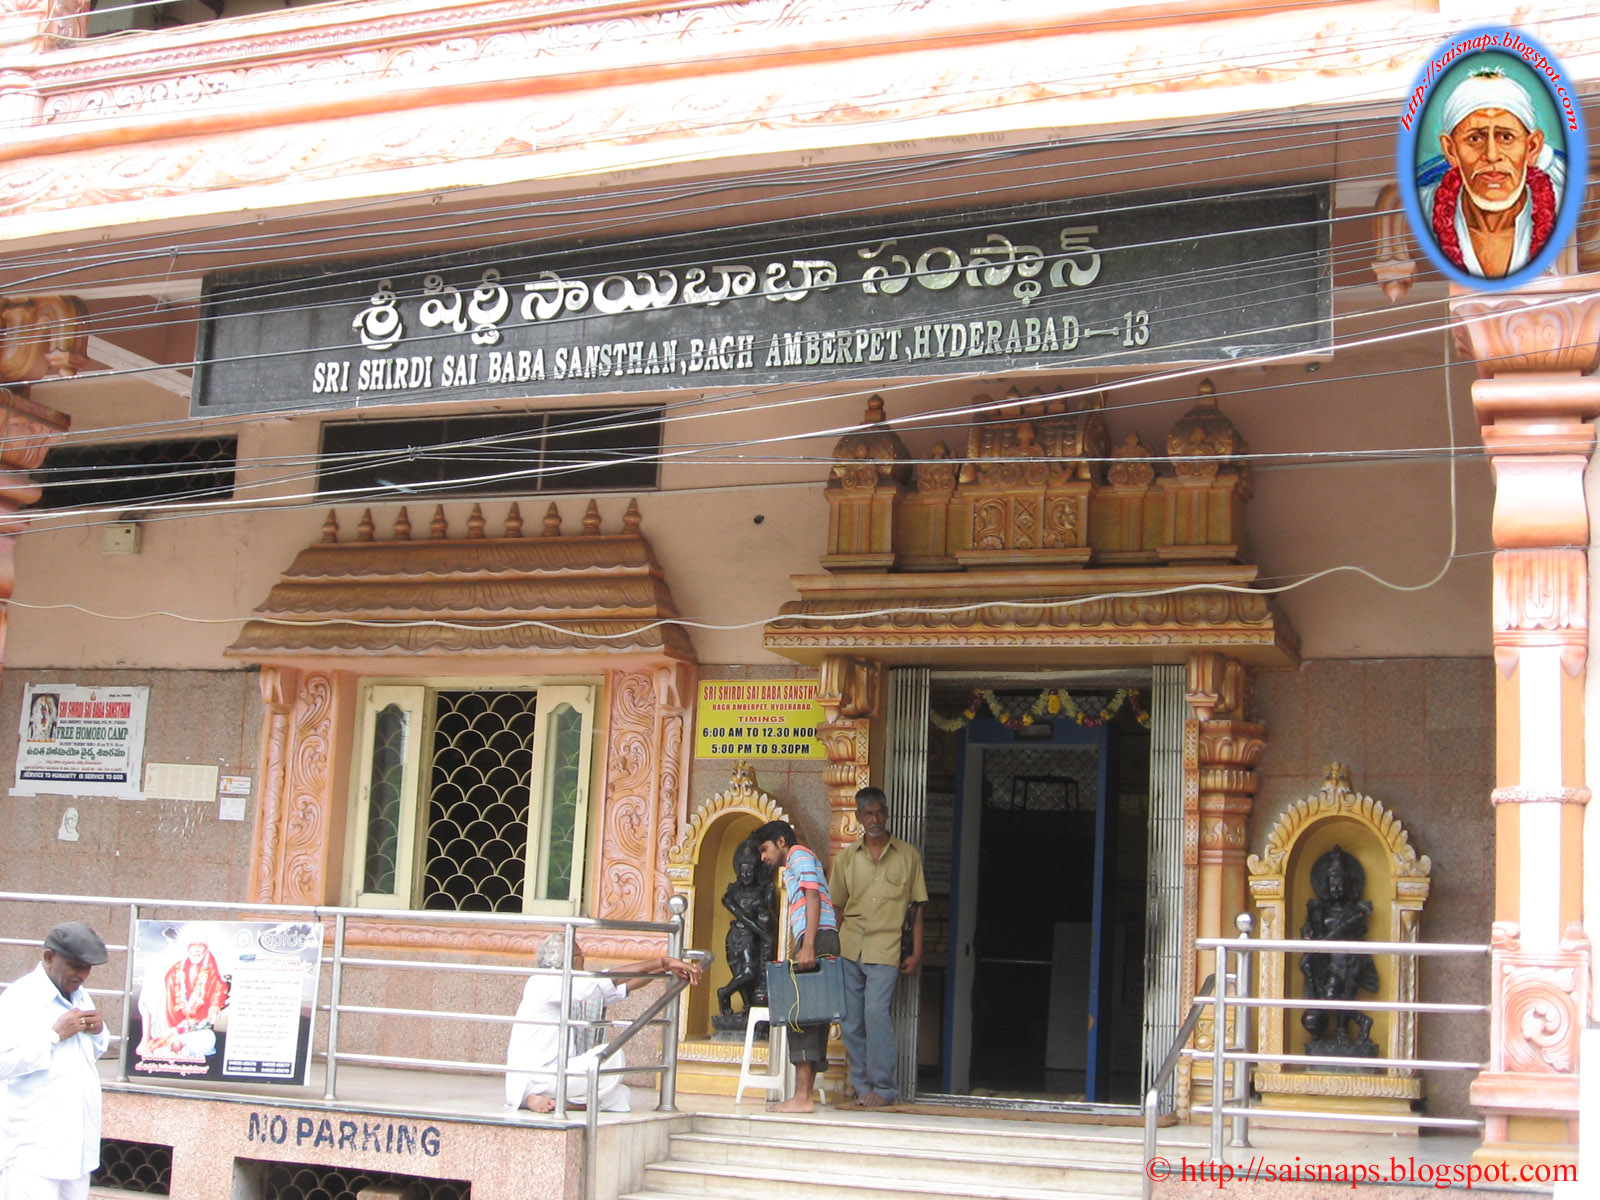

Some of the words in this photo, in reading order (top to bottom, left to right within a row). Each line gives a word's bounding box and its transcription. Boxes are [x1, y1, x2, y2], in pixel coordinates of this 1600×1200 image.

[352, 279, 404, 350] శ్రీ
[312, 361, 350, 393] SRI
[358, 356, 433, 390] SHIRDI
[441, 353, 478, 387] SAI
[488, 348, 546, 383] BABA
[704, 686, 717, 700] SRI
[719, 686, 745, 700] SHIRDI
[747, 686, 759, 700] SAI
[761, 686, 781, 700] BABA
[56, 726, 74, 739] FREE
[108, 727, 129, 740] CAMP
[703, 728, 725, 737] 6:00
[728, 728, 743, 737] AM
[747, 728, 759, 737] TO
[763, 728, 790, 737] 12.30
[793, 728, 817, 737] NOO
[712, 744, 734, 754] 5:00
[738, 744, 752, 754] PM
[756, 744, 768, 754] TO
[249, 1112, 288, 1144] NO
[297, 1117, 441, 1157] PARKING
